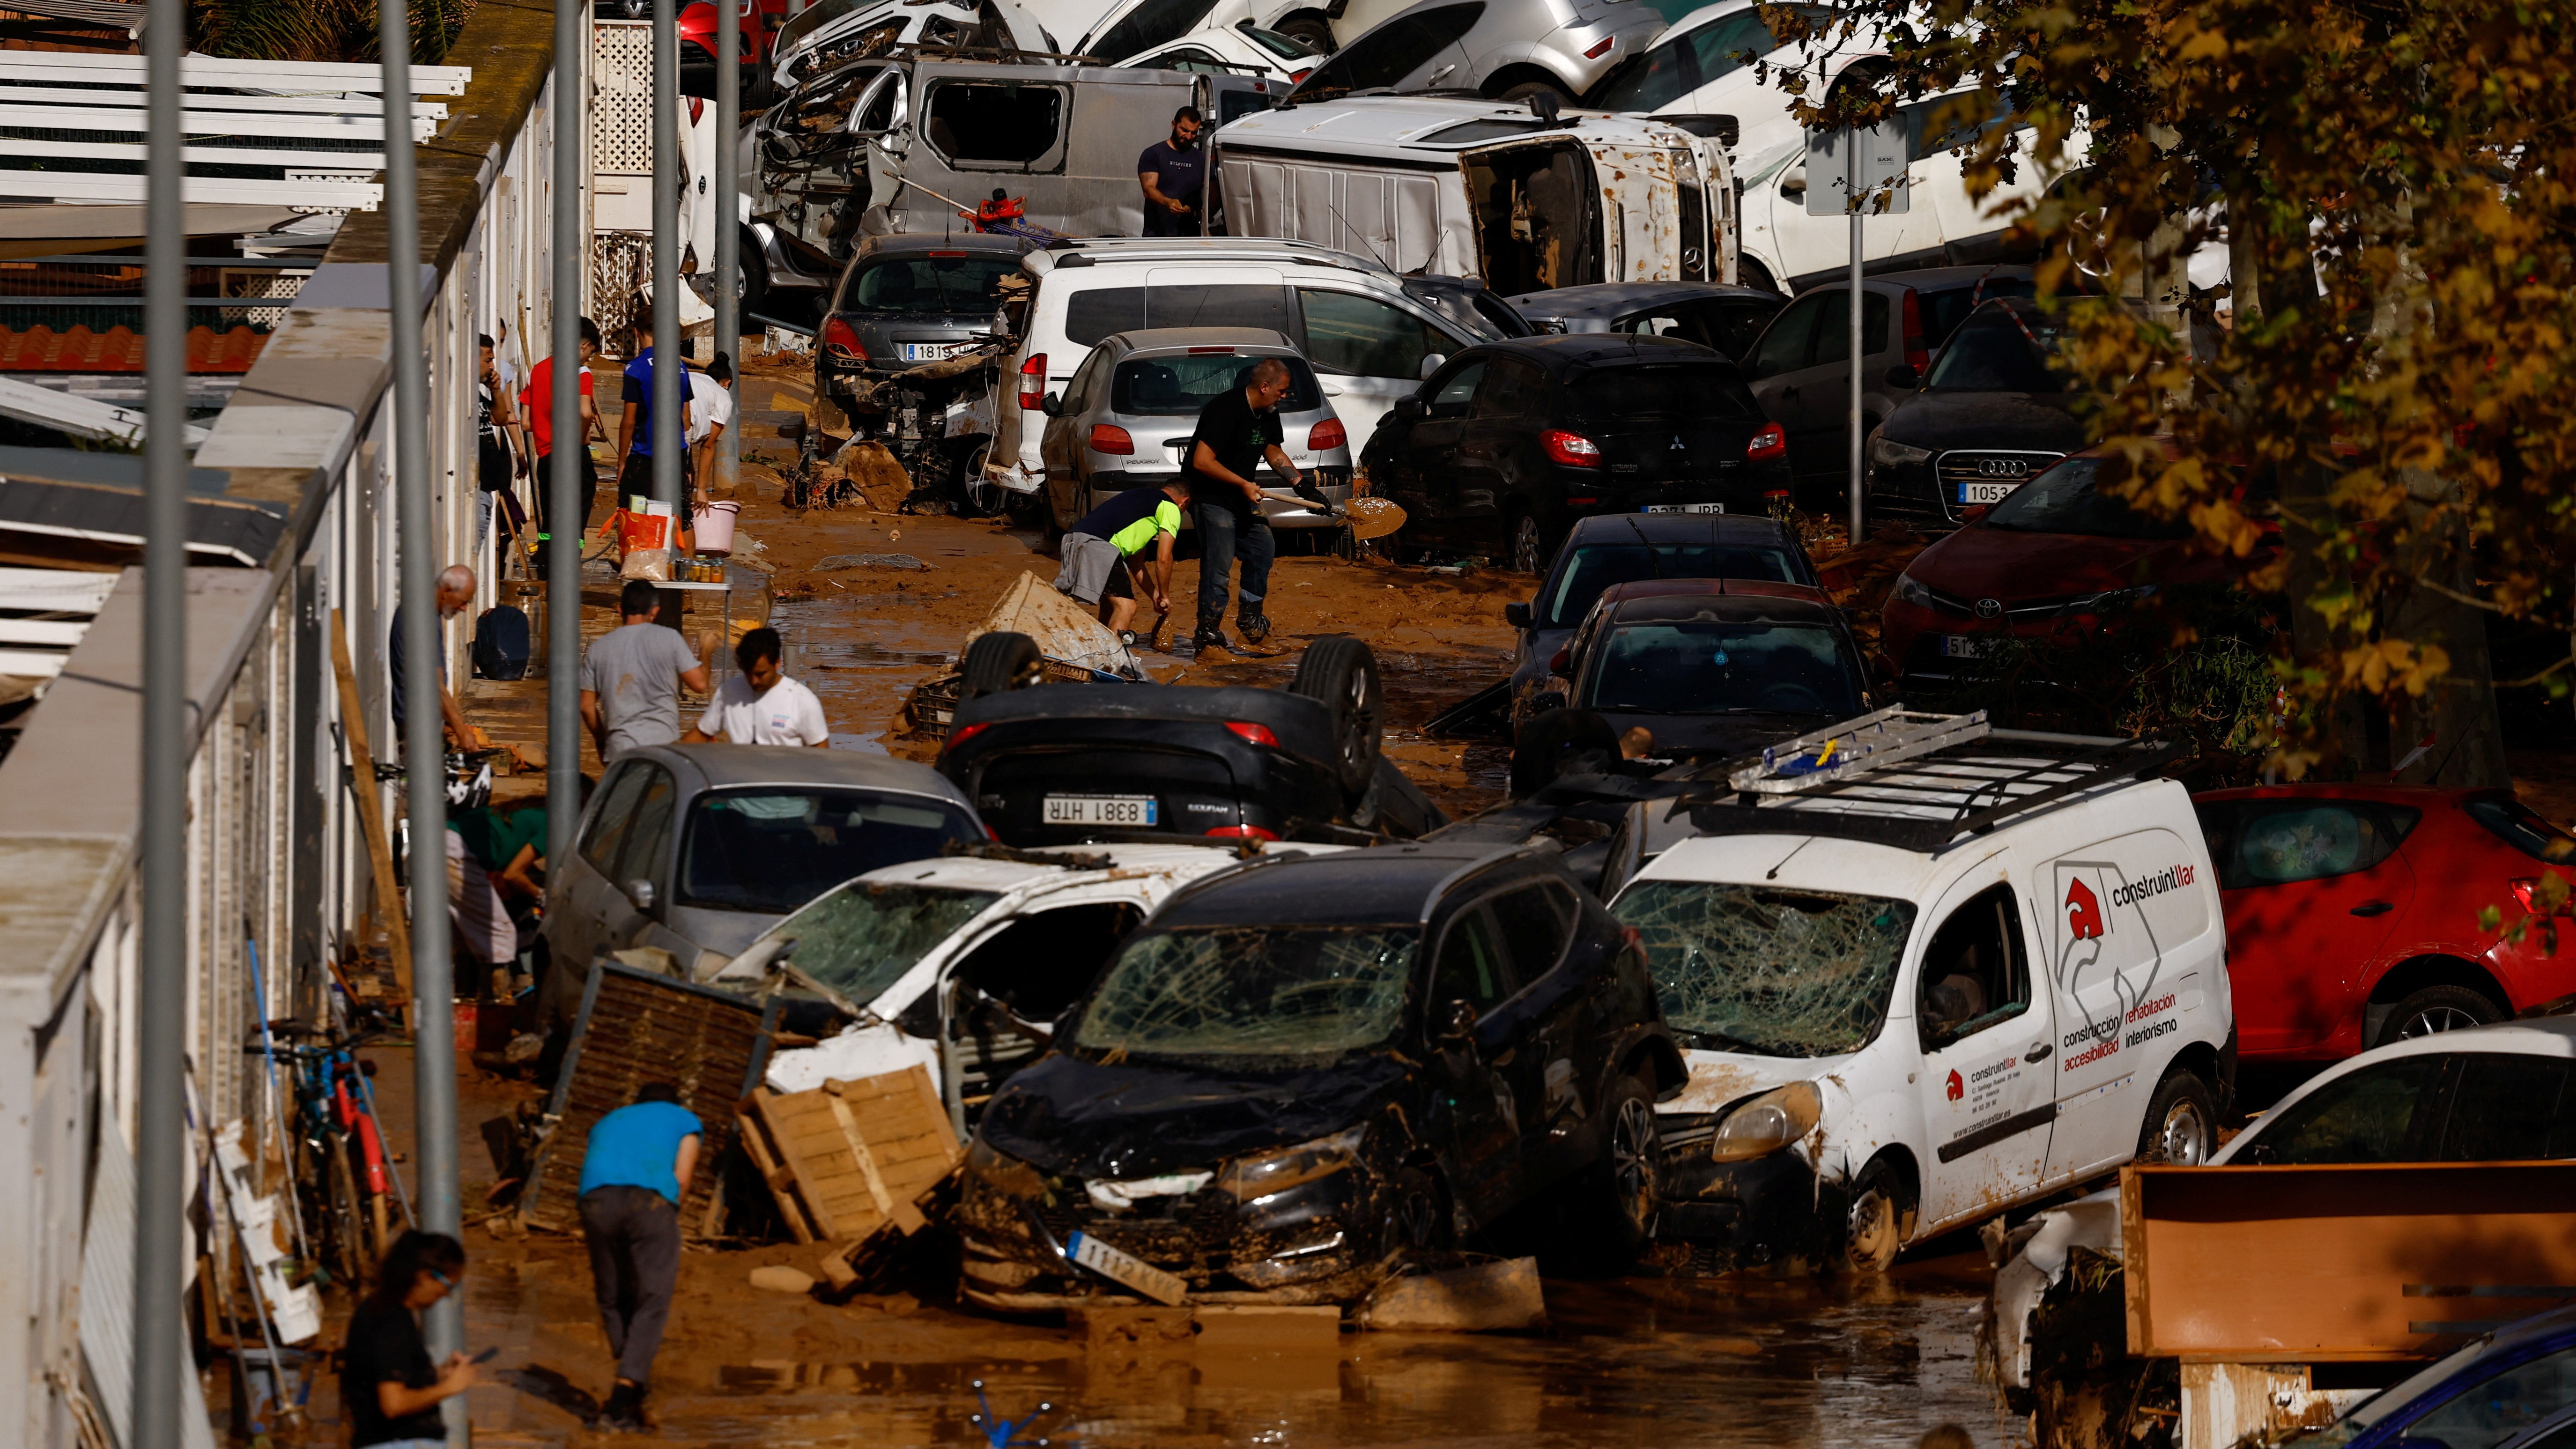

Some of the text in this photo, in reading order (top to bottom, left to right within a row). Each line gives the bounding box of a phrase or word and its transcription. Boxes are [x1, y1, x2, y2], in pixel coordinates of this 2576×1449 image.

[920, 346, 951, 358] 1819
[1972, 487, 2008, 500] 1053
[1951, 638, 1976, 655] 513
[1051, 801, 1138, 821] 8381 HTR
[2113, 864, 2194, 907] construintllar
[2064, 1015, 2119, 1048] construcción
[2065, 1019, 2177, 1072] accesibilidad interiorismo
[1971, 1057, 2016, 1083] construintllar
[1953, 1109, 2011, 1138] www.construintllar.es
